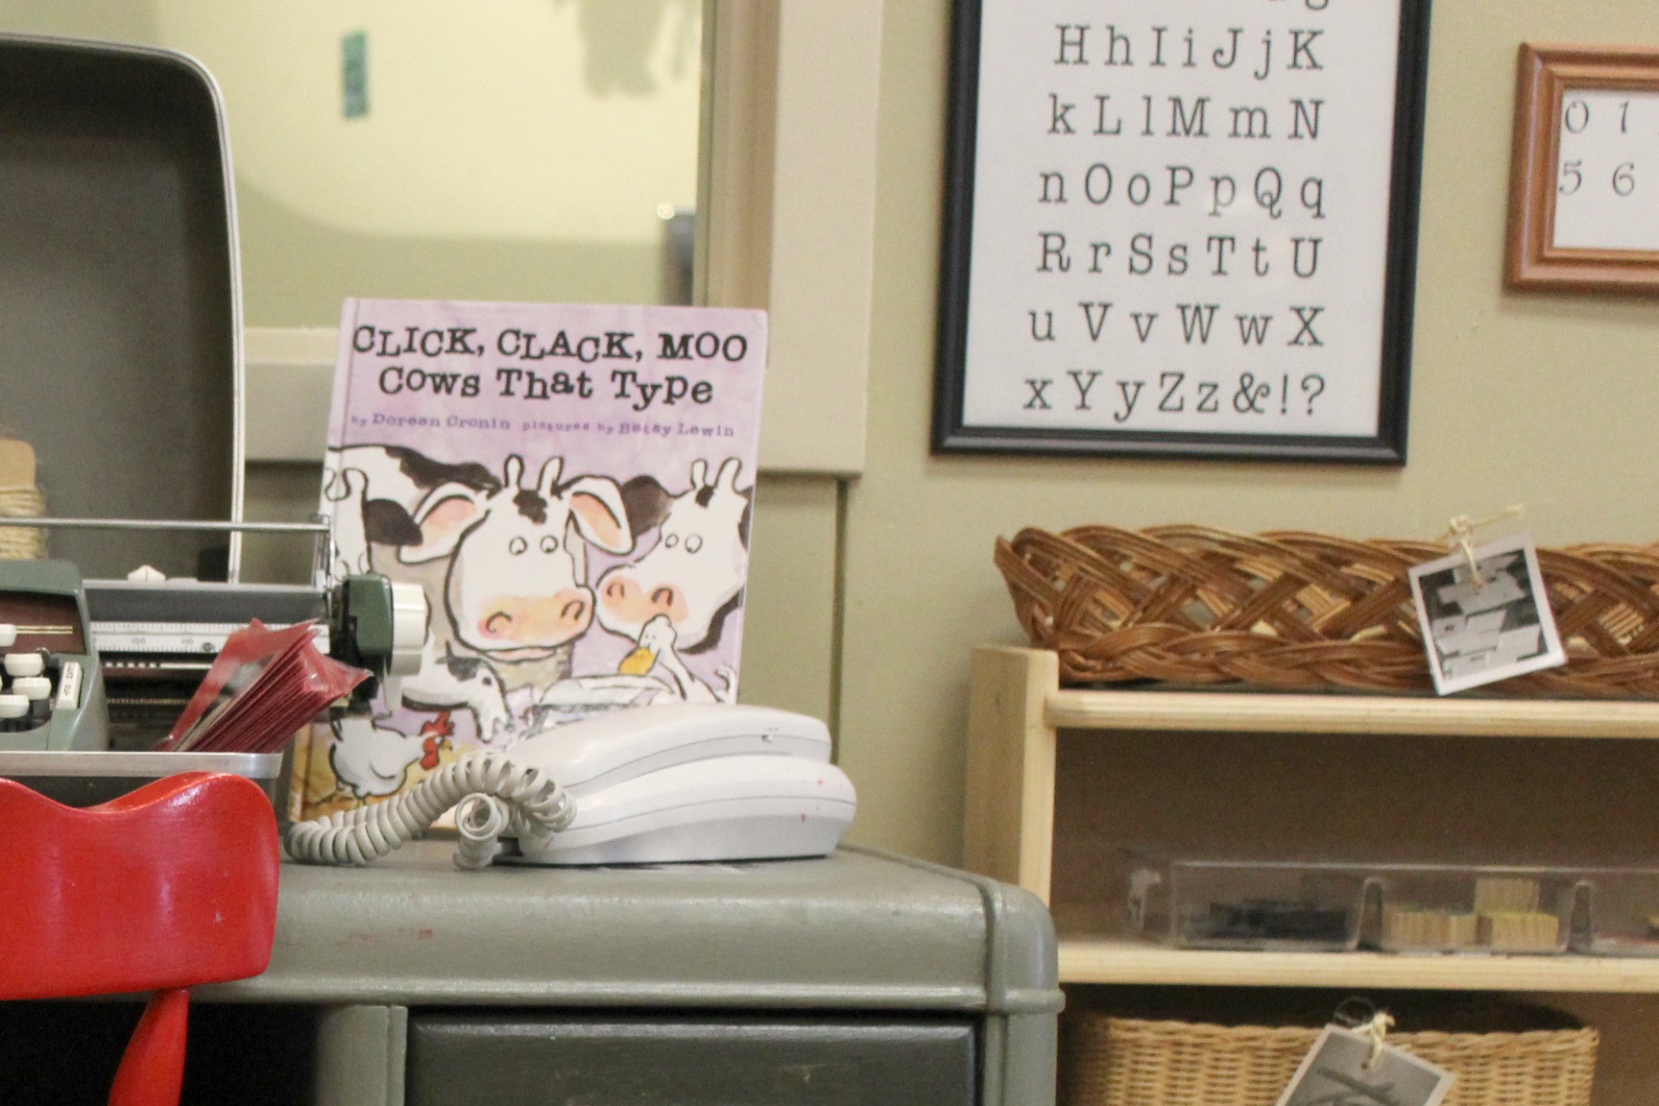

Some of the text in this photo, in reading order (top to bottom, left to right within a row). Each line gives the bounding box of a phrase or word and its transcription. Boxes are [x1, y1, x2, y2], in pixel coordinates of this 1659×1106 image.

[1564, 100, 1590, 134] 0
[1559, 159, 1635, 197] 5 6
[351, 324, 748, 364] CLICK, CLACK, MOO
[378, 366, 713, 412] Cows That Type
[372, 411, 440, 428] Doreen
[446, 414, 511, 430] Cronin
[678, 422, 735, 437] Lewin
